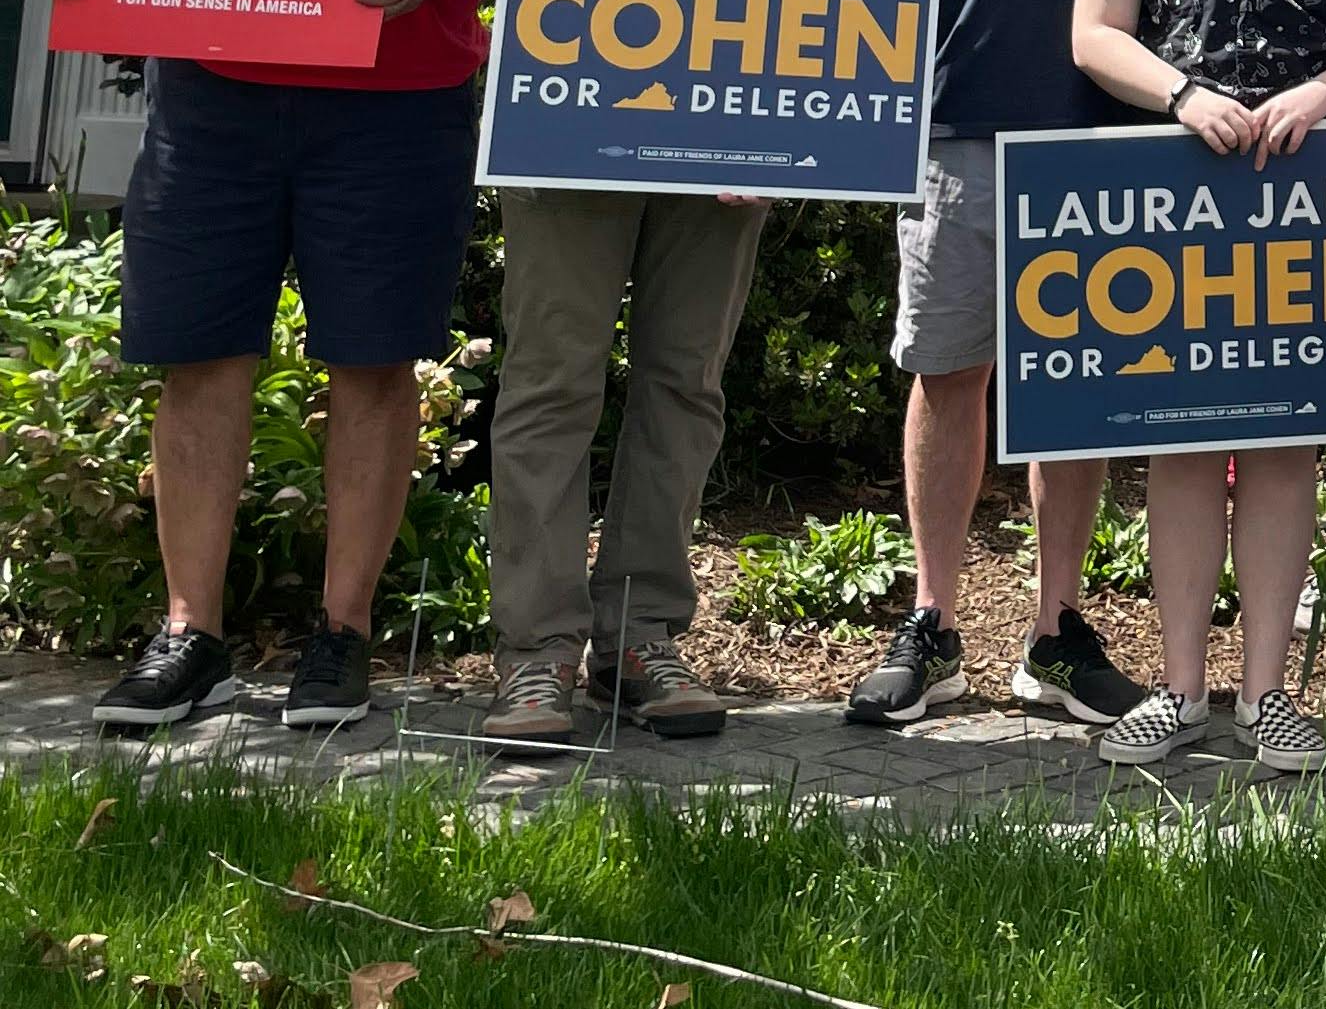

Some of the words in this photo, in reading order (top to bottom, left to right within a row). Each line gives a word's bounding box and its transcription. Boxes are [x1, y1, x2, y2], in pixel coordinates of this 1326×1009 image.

[511, 74, 600, 108] FOR
[690, 83, 914, 124] DELEGATE
[723, 153, 746, 161] LAURA
[747, 154, 764, 162] JANE
[764, 155, 788, 163] COHEN
[1017, 185, 1225, 240] LAURA
[1019, 348, 1104, 381] FOR
[1226, 407, 1248, 416] LAURA
[1249, 406, 1265, 415] JANE
[1265, 405, 1289, 413] COHEN
